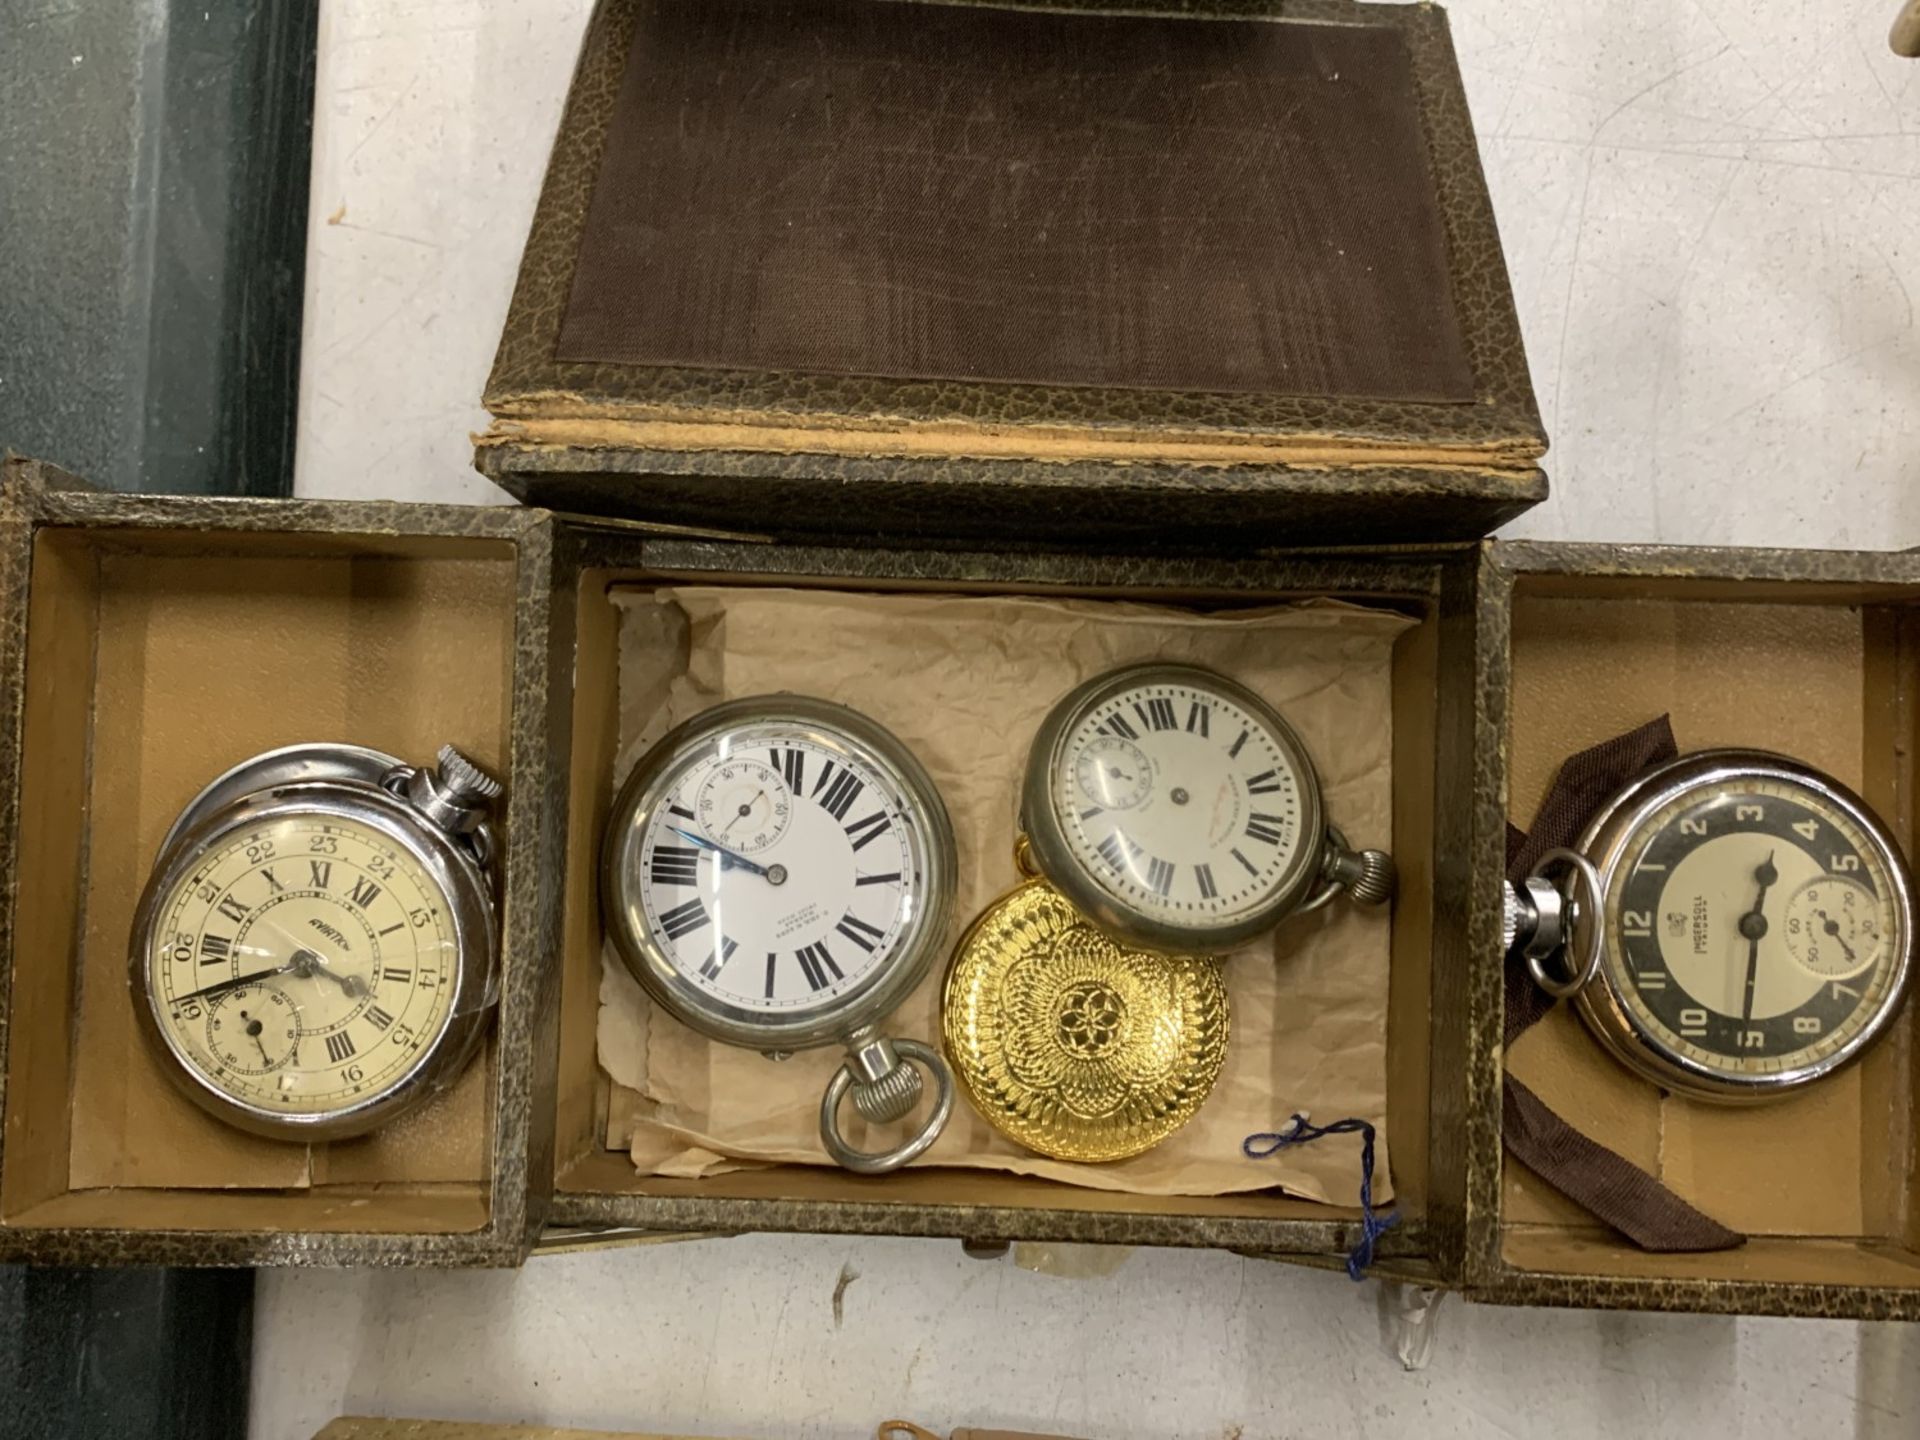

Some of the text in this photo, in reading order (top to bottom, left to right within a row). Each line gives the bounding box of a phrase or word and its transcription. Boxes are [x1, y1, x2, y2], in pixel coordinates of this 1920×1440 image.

[1132, 698, 1178, 733] VIII
[810, 759, 865, 822] VIII
[1736, 805, 1764, 821] 3
[1680, 819, 1707, 835] 2
[1791, 819, 1820, 841] 4
[247, 840, 276, 864] 22
[310, 836, 338, 854] 23
[308, 860, 332, 889] XI
[367, 855, 395, 881] 24
[651, 845, 700, 887] IIII
[1831, 855, 1859, 871] 5
[197, 880, 222, 904] 21
[261, 866, 284, 895] X
[344, 875, 382, 910] XII
[1807, 890, 1818, 901] 10
[1844, 891, 1854, 906] 20
[217, 893, 252, 923] IX
[410, 908, 431, 928] 13
[658, 896, 712, 942] III
[378, 922, 405, 937] I
[1623, 910, 1651, 937] 12
[1693, 896, 1707, 954] INGERSOLL
[1789, 918, 1800, 934] 60
[174, 932, 194, 962] 20
[200, 933, 232, 967] VIII
[1808, 947, 1819, 962] 50
[383, 967, 411, 983] II
[419, 968, 437, 990] 14
[1638, 972, 1666, 989] 11
[1832, 982, 1860, 1000] 7
[181, 999, 201, 1020] 19
[363, 1004, 394, 1032] III
[1680, 1008, 1707, 1036] 10
[1793, 1017, 1821, 1034] 8
[392, 1023, 415, 1046] 15
[325, 1030, 356, 1063] IIII
[340, 1065, 364, 1084] 16
